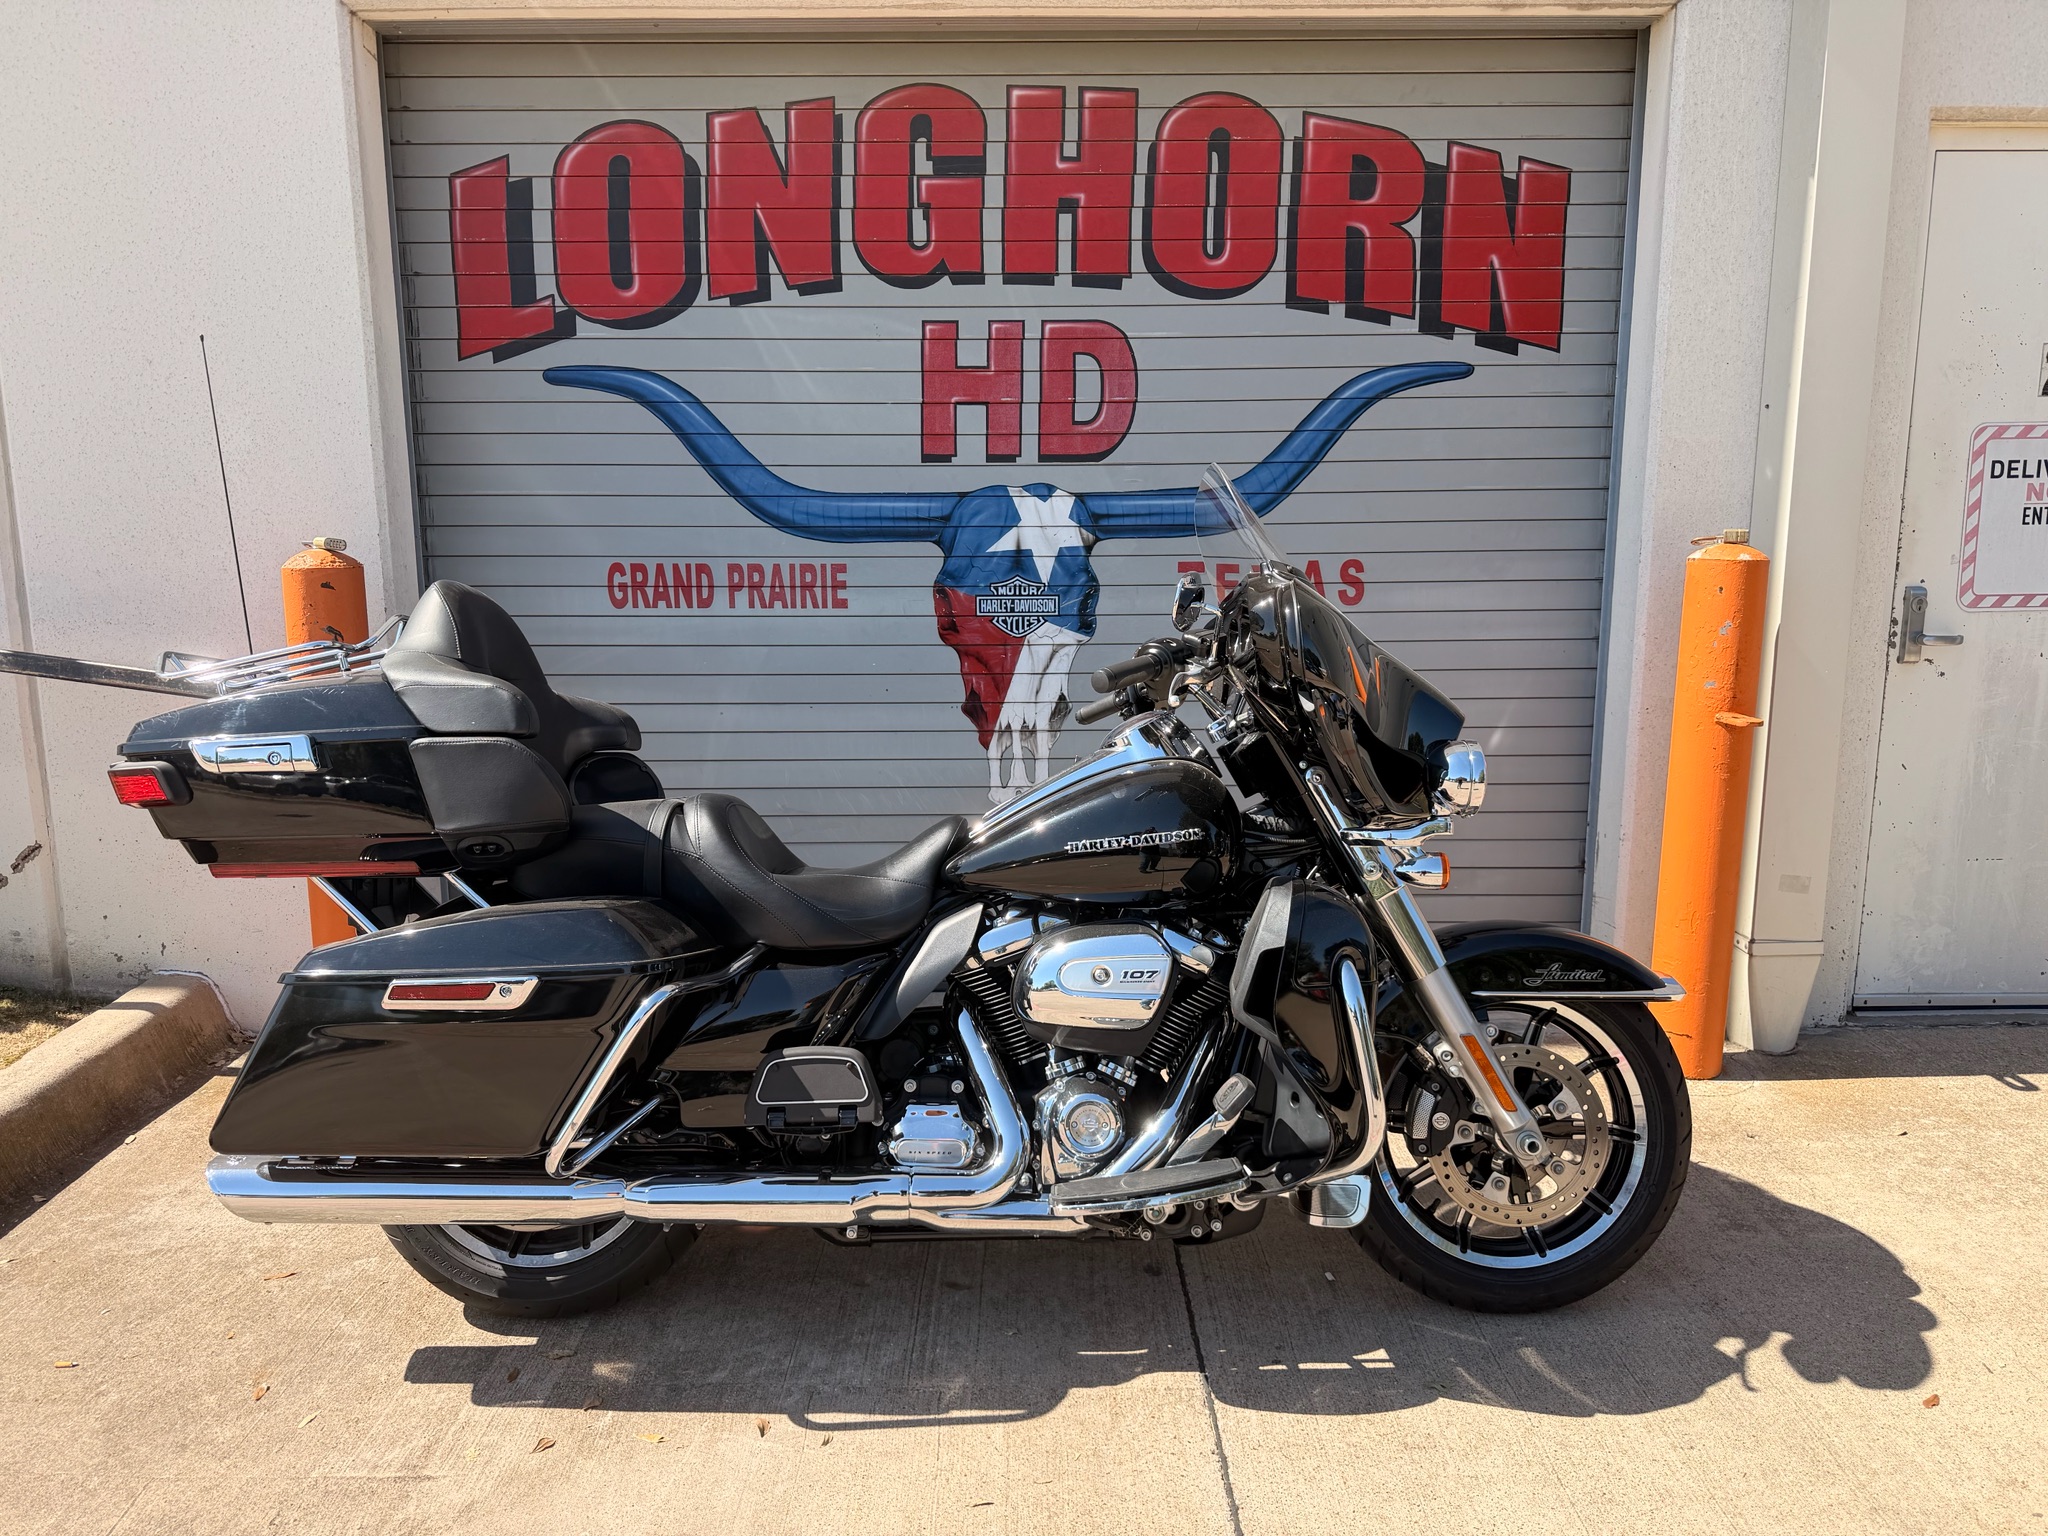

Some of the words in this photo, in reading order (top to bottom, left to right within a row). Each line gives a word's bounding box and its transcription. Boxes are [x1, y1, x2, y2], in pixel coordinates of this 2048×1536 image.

[449, 83, 1572, 364] LONGHORN
[921, 319, 1138, 463] HD
[1990, 459, 2048, 479] DELI
[2026, 482, 2048, 501] N
[607, 562, 715, 609] GRAND
[726, 563, 848, 609] PRAIRIE
[998, 581, 1039, 596] MOTOR
[980, 599, 1056, 613] HARLEY-DAVIDSON
[998, 616, 1039, 635] CYCLES
[1121, 969, 1160, 980] 107
[1523, 962, 1606, 987] Limited
